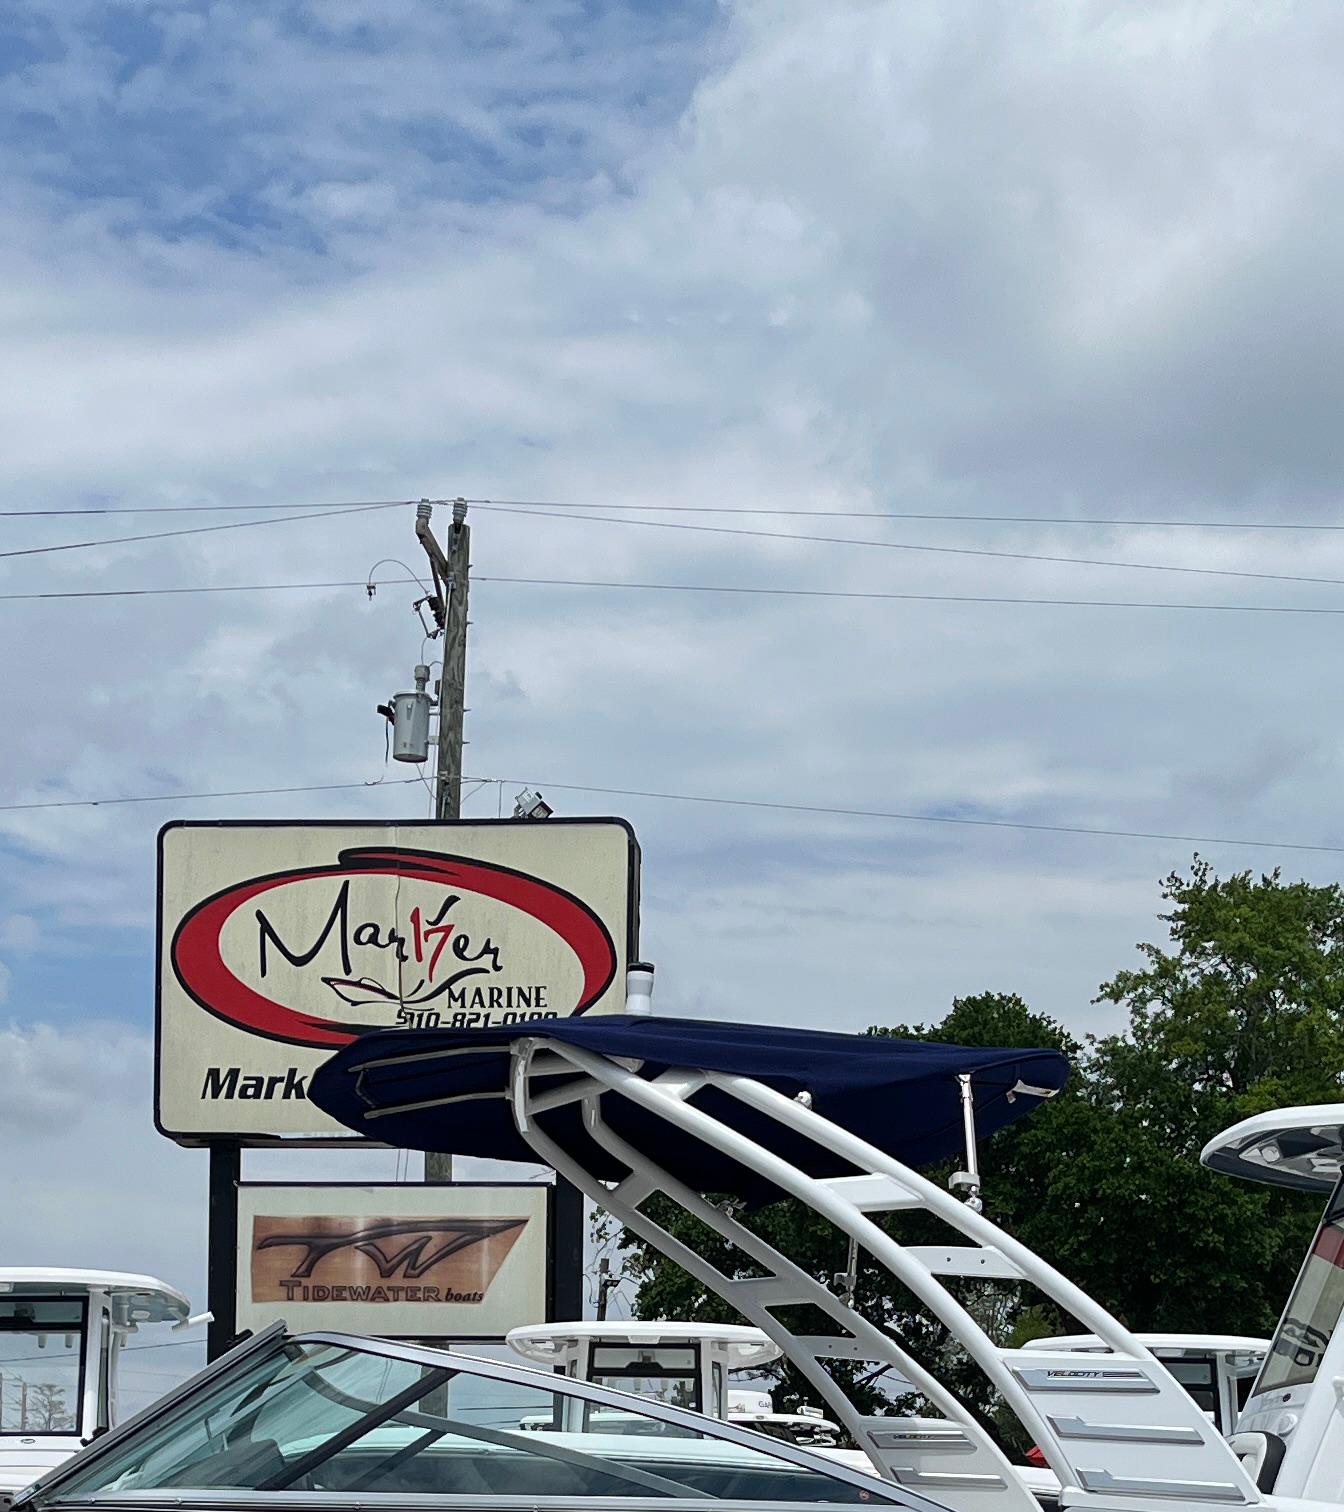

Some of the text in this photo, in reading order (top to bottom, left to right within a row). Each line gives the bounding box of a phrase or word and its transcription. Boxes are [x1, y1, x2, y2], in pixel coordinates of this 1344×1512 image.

[447, 985, 548, 1009] MARINE
[279, 1279, 485, 1304] TIDEWATER boats
